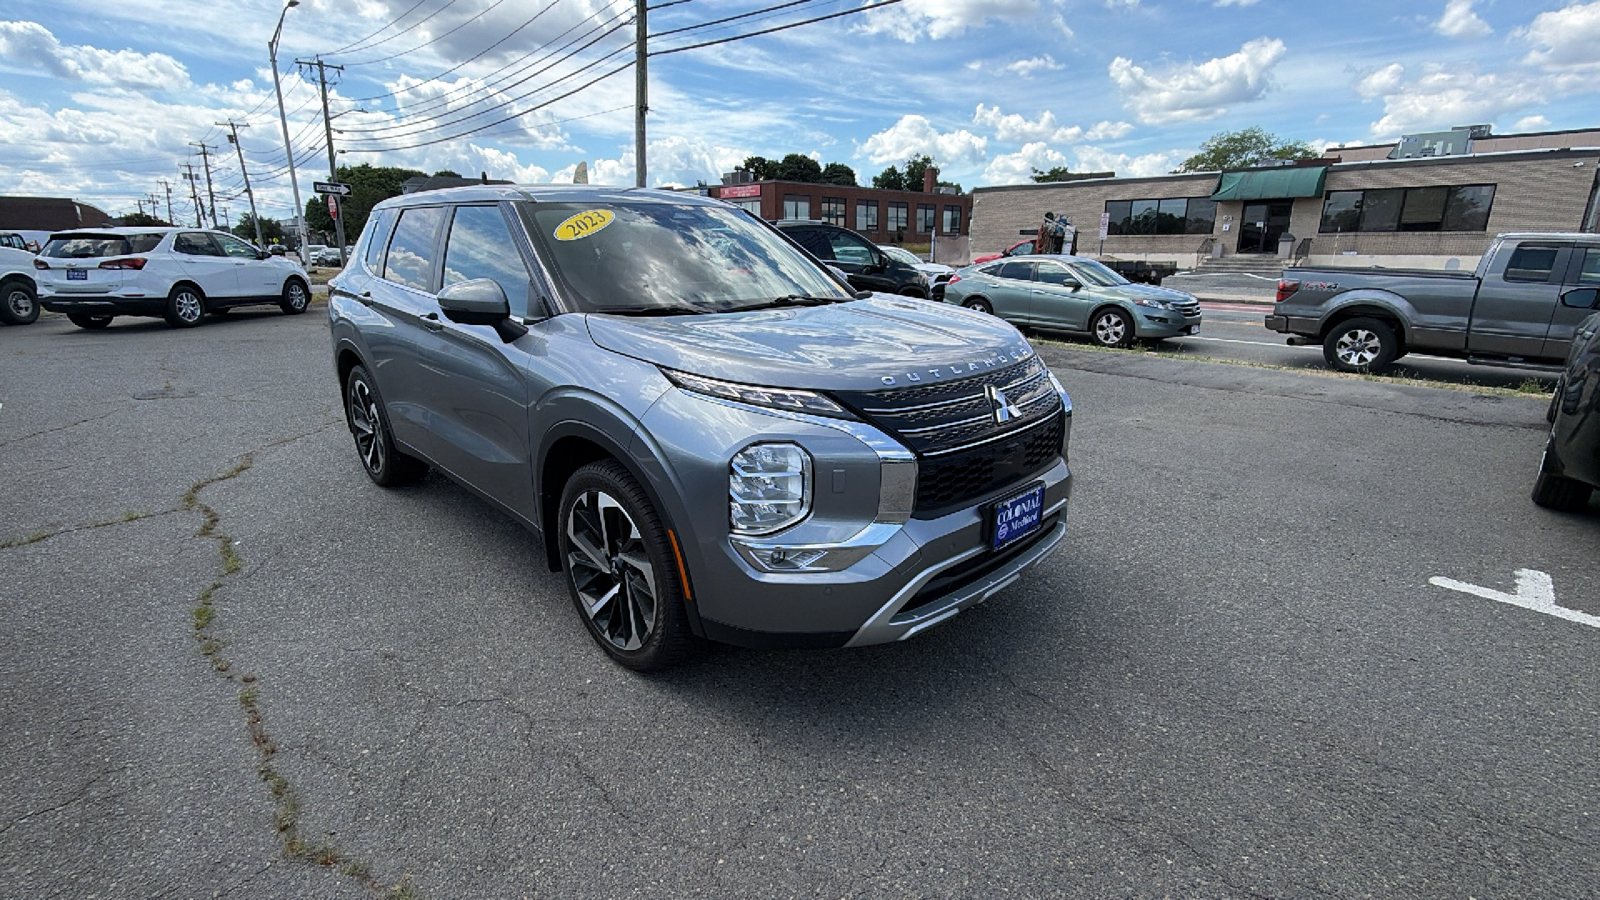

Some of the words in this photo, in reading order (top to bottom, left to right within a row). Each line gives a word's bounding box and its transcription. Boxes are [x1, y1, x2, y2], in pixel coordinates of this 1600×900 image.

[566, 211, 606, 237] 2023
[1303, 281, 1339, 291] FX4
[881, 349, 1029, 386] OUTLANDER
[997, 496, 1040, 525] COLONIAL
